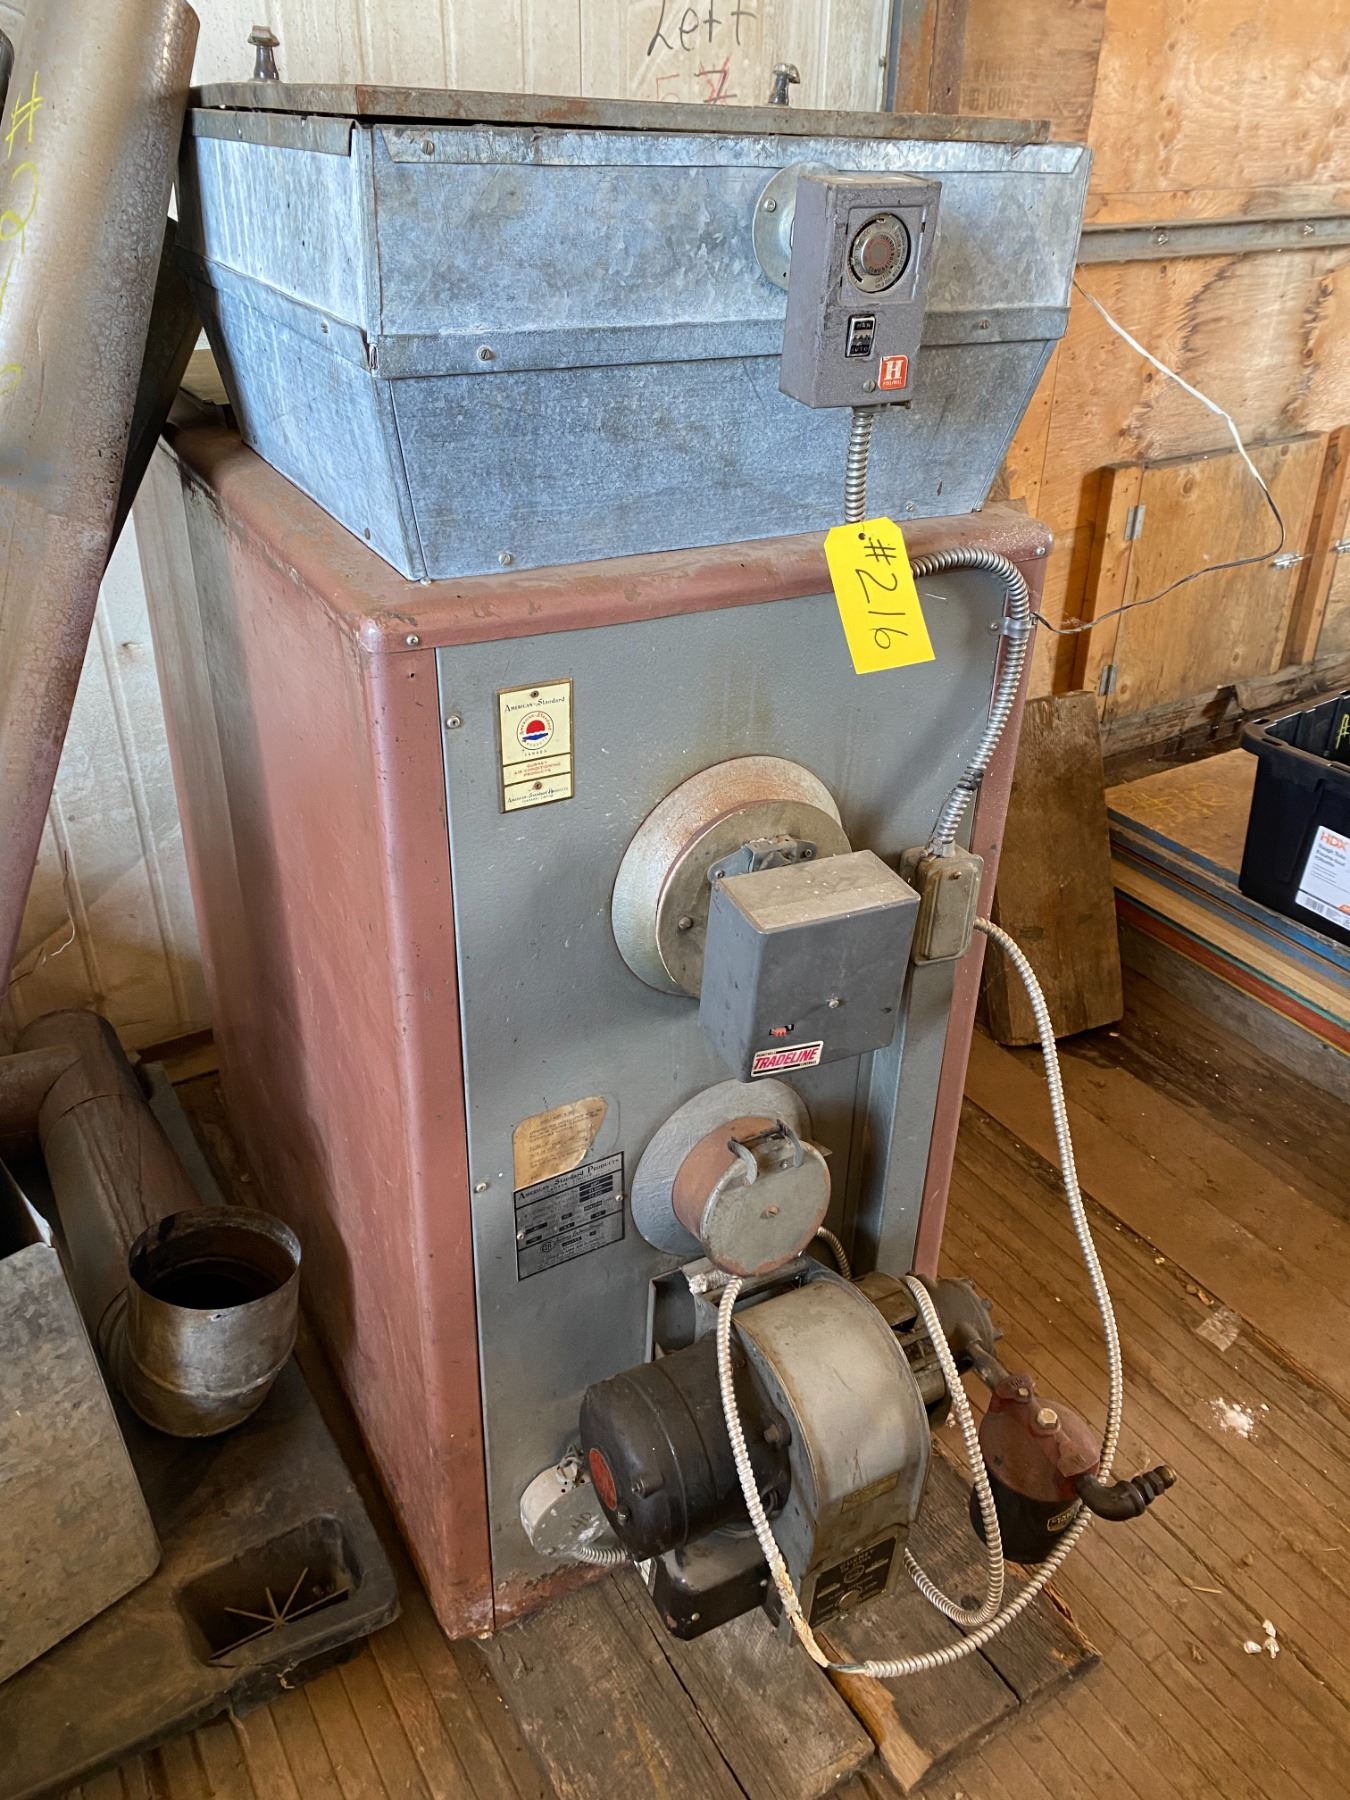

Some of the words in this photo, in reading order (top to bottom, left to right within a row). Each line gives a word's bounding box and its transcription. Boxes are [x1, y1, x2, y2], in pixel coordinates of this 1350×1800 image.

[884, 359, 904, 381] H
[855, 537, 909, 650] #216
[753, 1047, 819, 1070] TRADELINE
